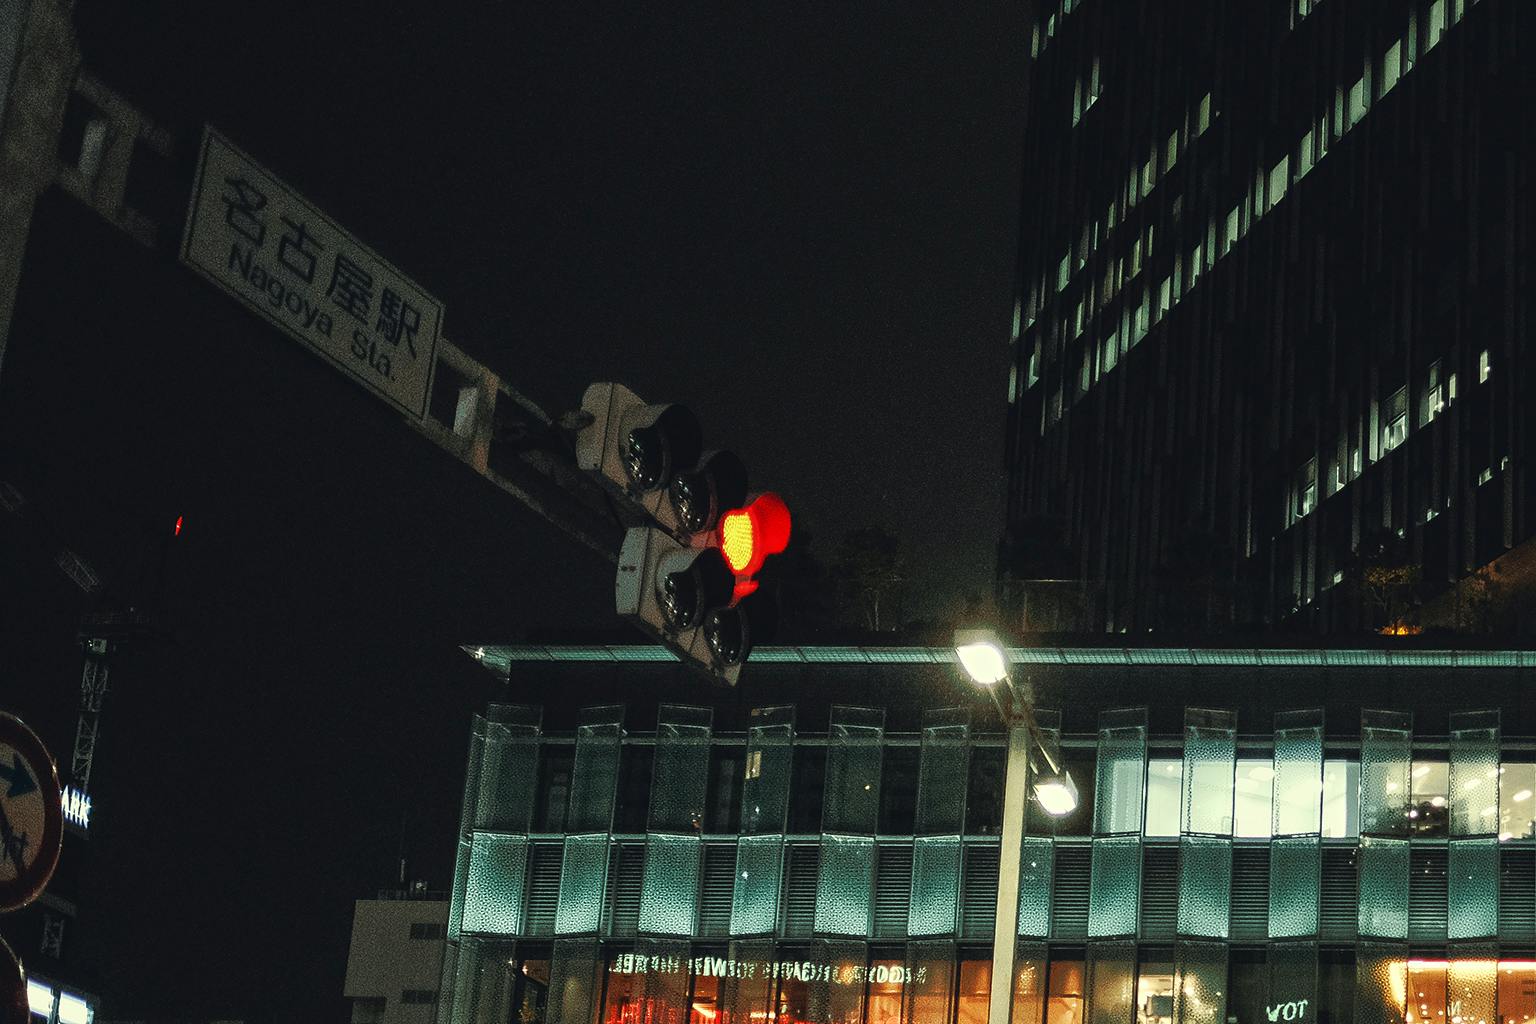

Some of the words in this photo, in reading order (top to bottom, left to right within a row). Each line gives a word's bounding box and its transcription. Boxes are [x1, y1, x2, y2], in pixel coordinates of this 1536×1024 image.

[222, 177, 421, 359] 名古屋駅
[228, 244, 333, 338] Nagoya
[351, 330, 399, 381] Sta.
[60, 785, 92, 829] ARK
